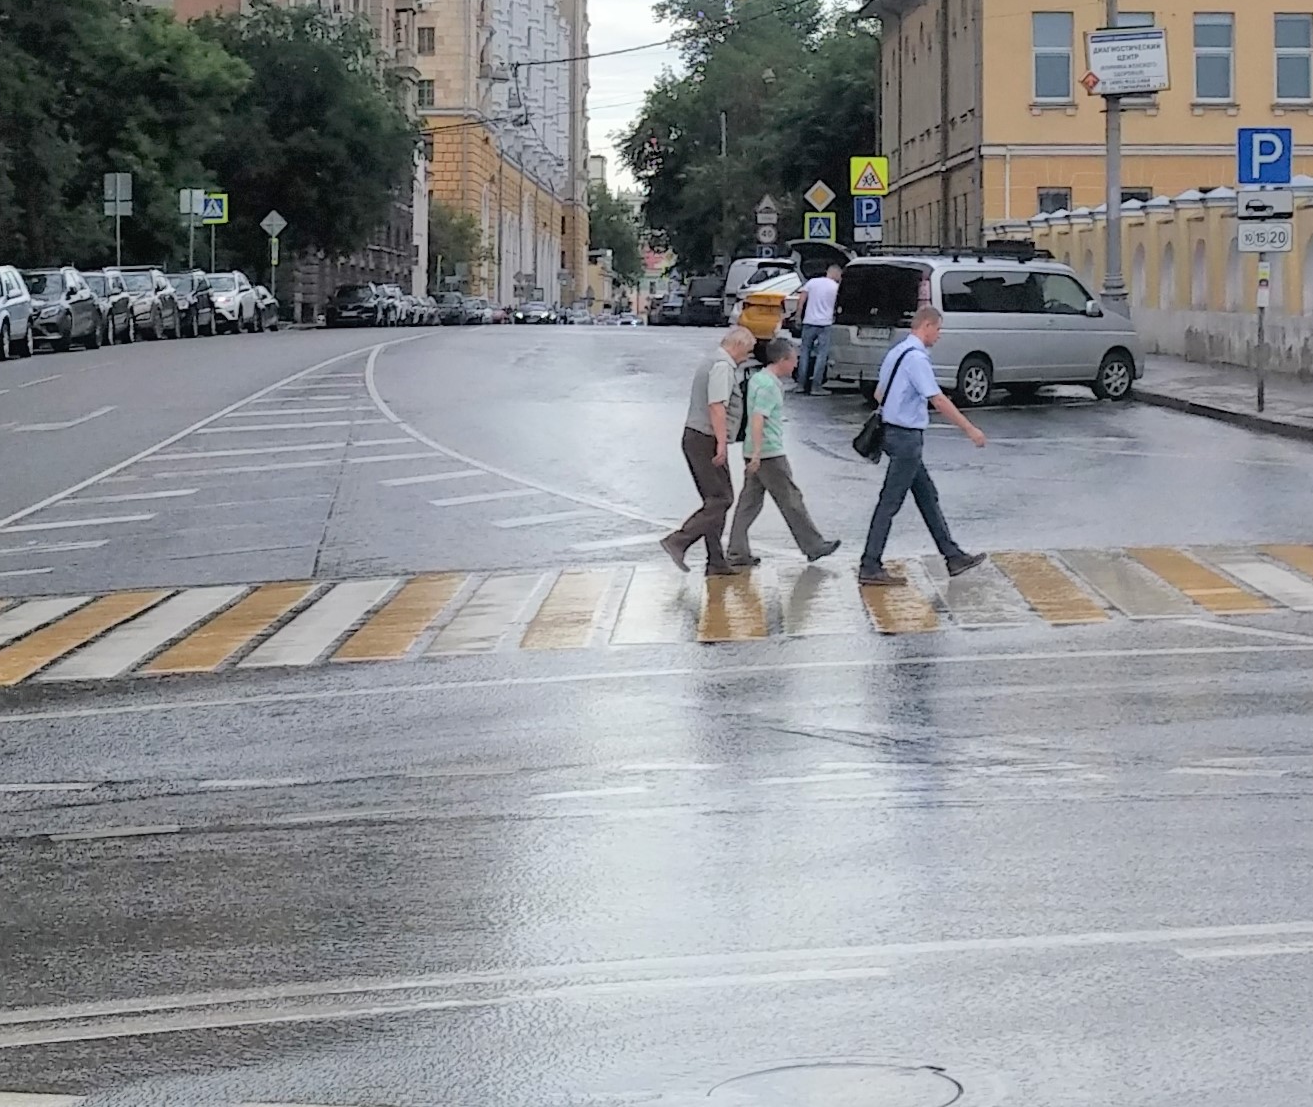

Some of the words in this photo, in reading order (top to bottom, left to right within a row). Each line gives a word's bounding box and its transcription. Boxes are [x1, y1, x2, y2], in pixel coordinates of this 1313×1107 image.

[1093, 43, 1161, 54] ДИАГНОСТИЧЕСКИЙ
[1116, 53, 1140, 62] ЦЕНТР
[1252, 133, 1284, 180] P
[862, 199, 878, 222] P
[761, 230, 774, 238] 40
[1245, 233, 1253, 242] 10
[1256, 232, 1266, 243] 15
[1270, 231, 1286, 243] 20
